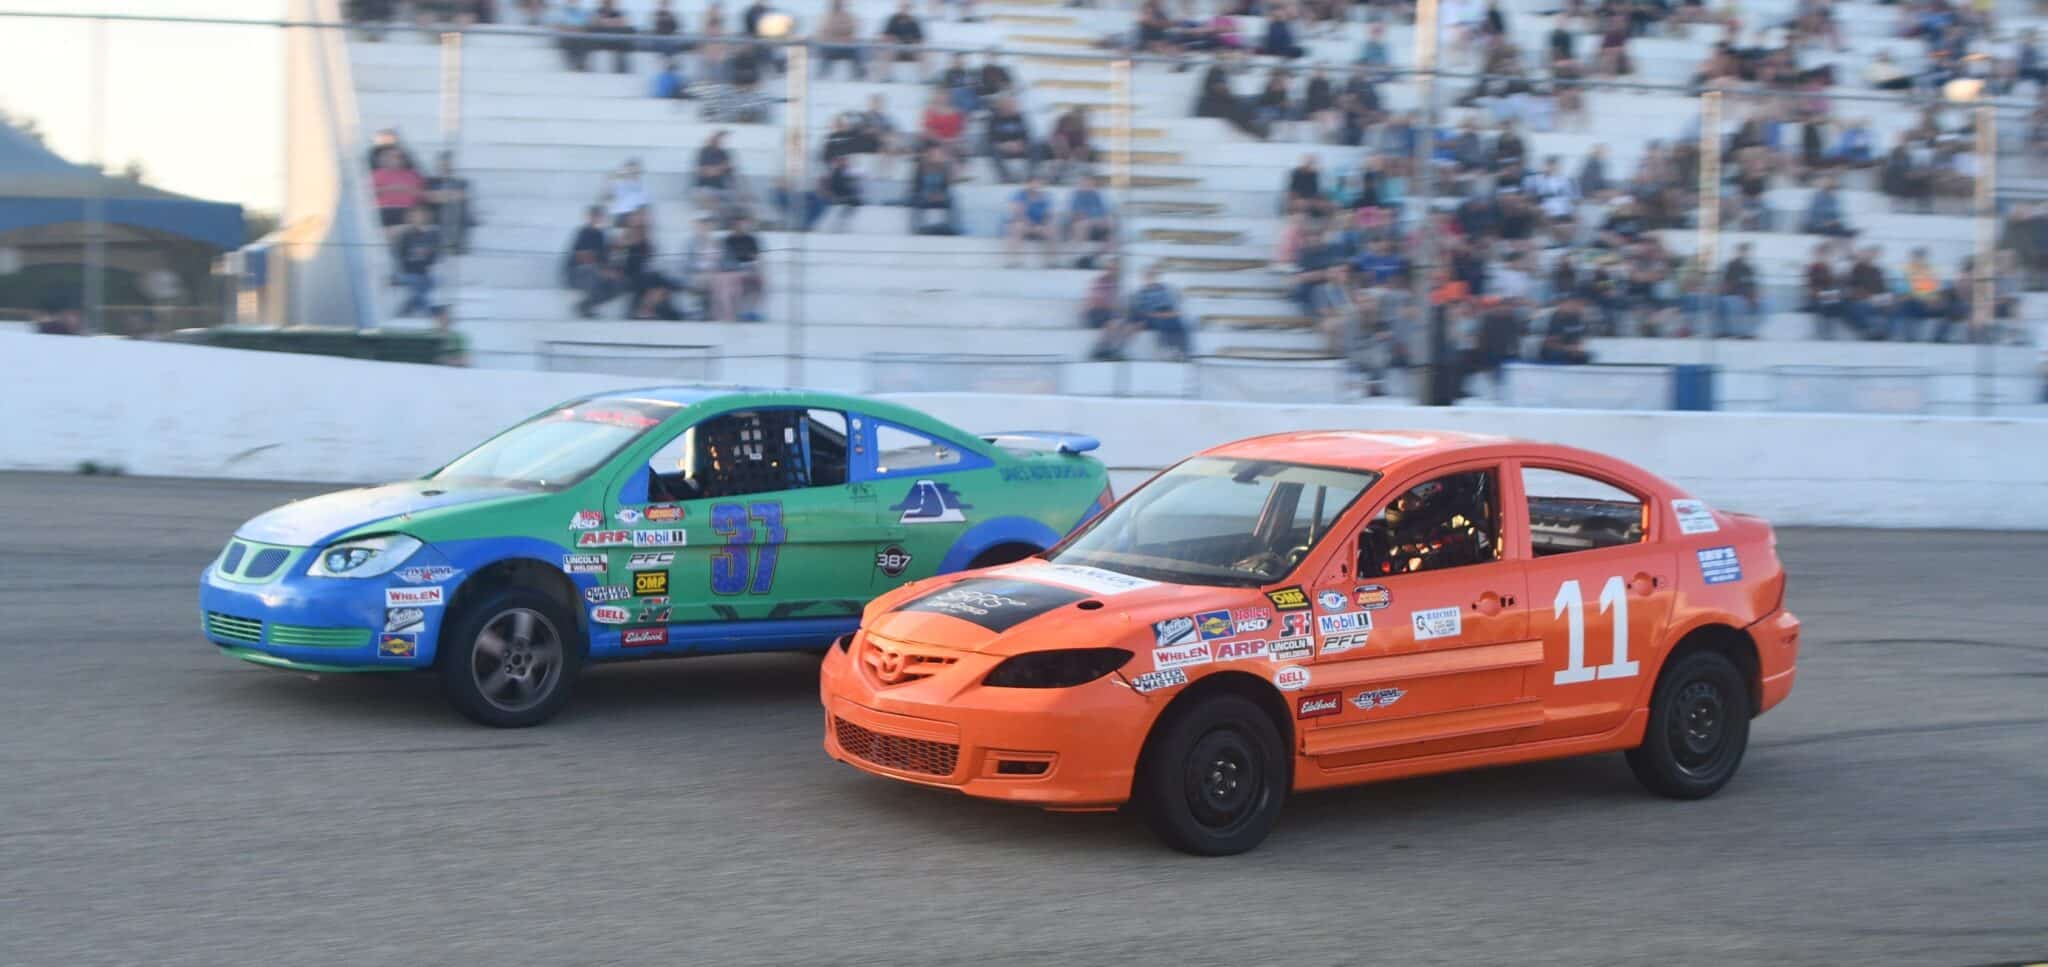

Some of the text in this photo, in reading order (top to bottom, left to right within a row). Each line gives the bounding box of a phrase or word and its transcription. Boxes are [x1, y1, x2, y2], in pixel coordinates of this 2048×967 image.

[580, 532, 631, 543] ARP
[636, 532, 669, 543] Mobil
[708, 502, 788, 596] 37
[630, 552, 675, 562] PFC
[877, 553, 912, 568] 387
[636, 576, 666, 588] OMP
[389, 589, 440, 600] WHELEN
[1272, 592, 1304, 605] OMP
[596, 608, 625, 620] BELL
[1237, 619, 1267, 633] MSD
[1321, 615, 1355, 632] Mobil
[1553, 575, 1640, 685] 11
[1270, 639, 1308, 652] LINCOLN
[1323, 633, 1368, 649] PFC
[1157, 645, 1209, 662] WHELEN
[1218, 642, 1265, 657] ARP
[1279, 673, 1306, 684] BELL
